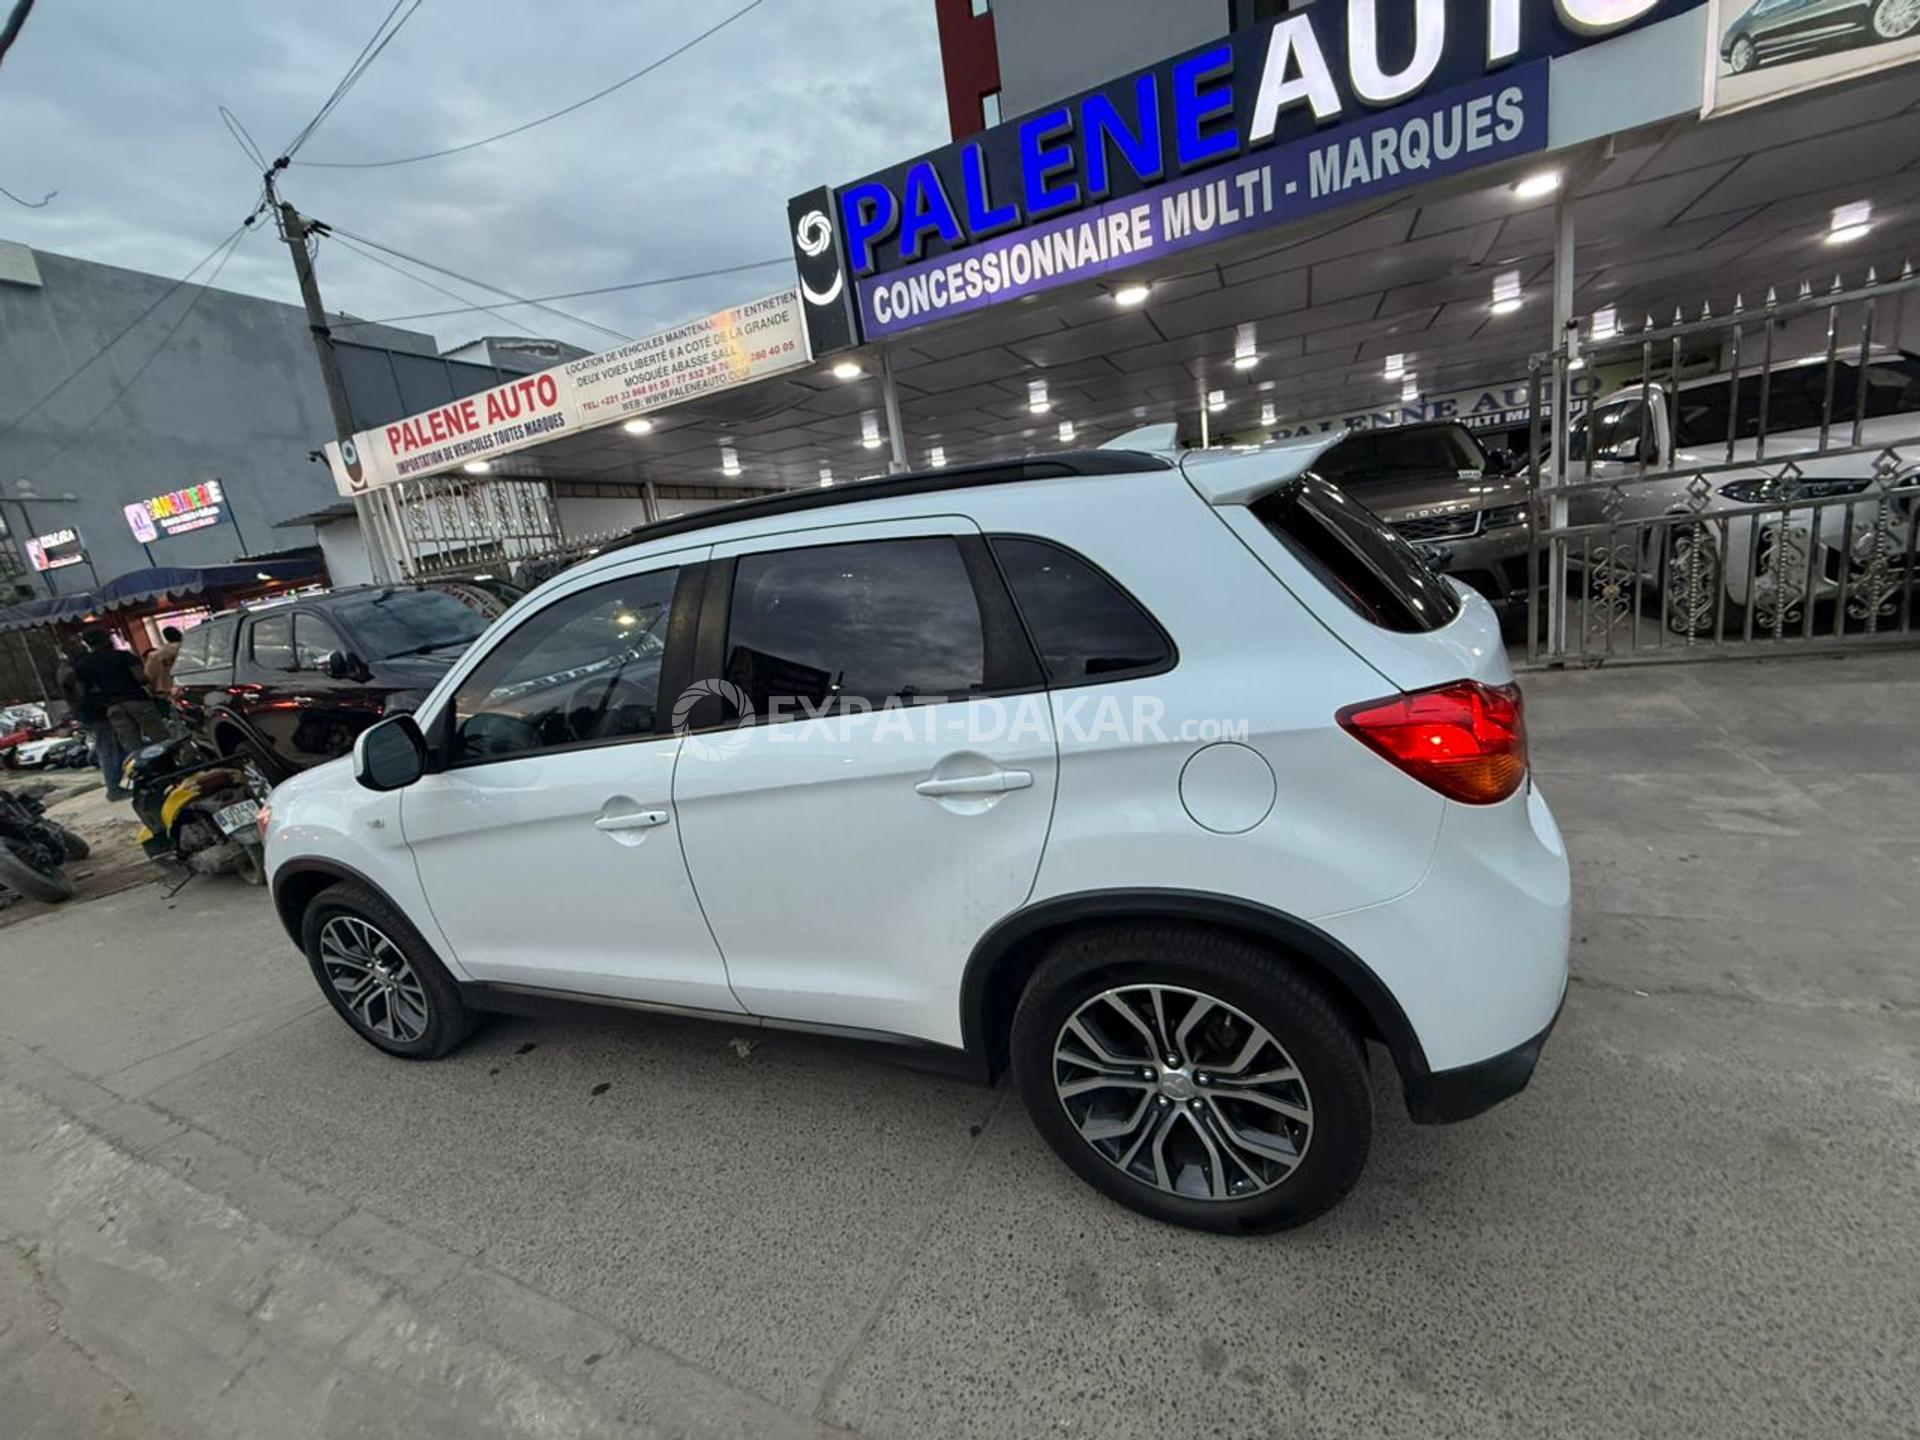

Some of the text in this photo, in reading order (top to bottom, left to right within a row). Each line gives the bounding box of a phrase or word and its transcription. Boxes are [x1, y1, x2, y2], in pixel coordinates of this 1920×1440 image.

[842, 0, 1666, 274] PALENE AU
[872, 86, 1525, 324] CONCESSIONNAIRE MULTI - MARQUES
[565, 354, 605, 375] LOCATION
[606, 351, 618, 363] DE
[617, 336, 664, 358] VEHICULES
[744, 291, 797, 317] ENTRETIEN
[576, 373, 600, 387] DEUX
[601, 362, 628, 379] VOIES
[713, 330, 728, 345] DE
[729, 327, 743, 340] LA
[744, 310, 790, 335] GRANDE
[672, 353, 709, 373] ABASSE
[711, 345, 737, 361] SALL
[768, 345, 780, 355] 40
[783, 340, 795, 351] 05
[386, 374, 558, 455] PALENE AUTO
[396, 412, 566, 475] IMPORTATION DE VEHICULES TOUTES MARQUES
[1464, 411, 1500, 428] ULTI
